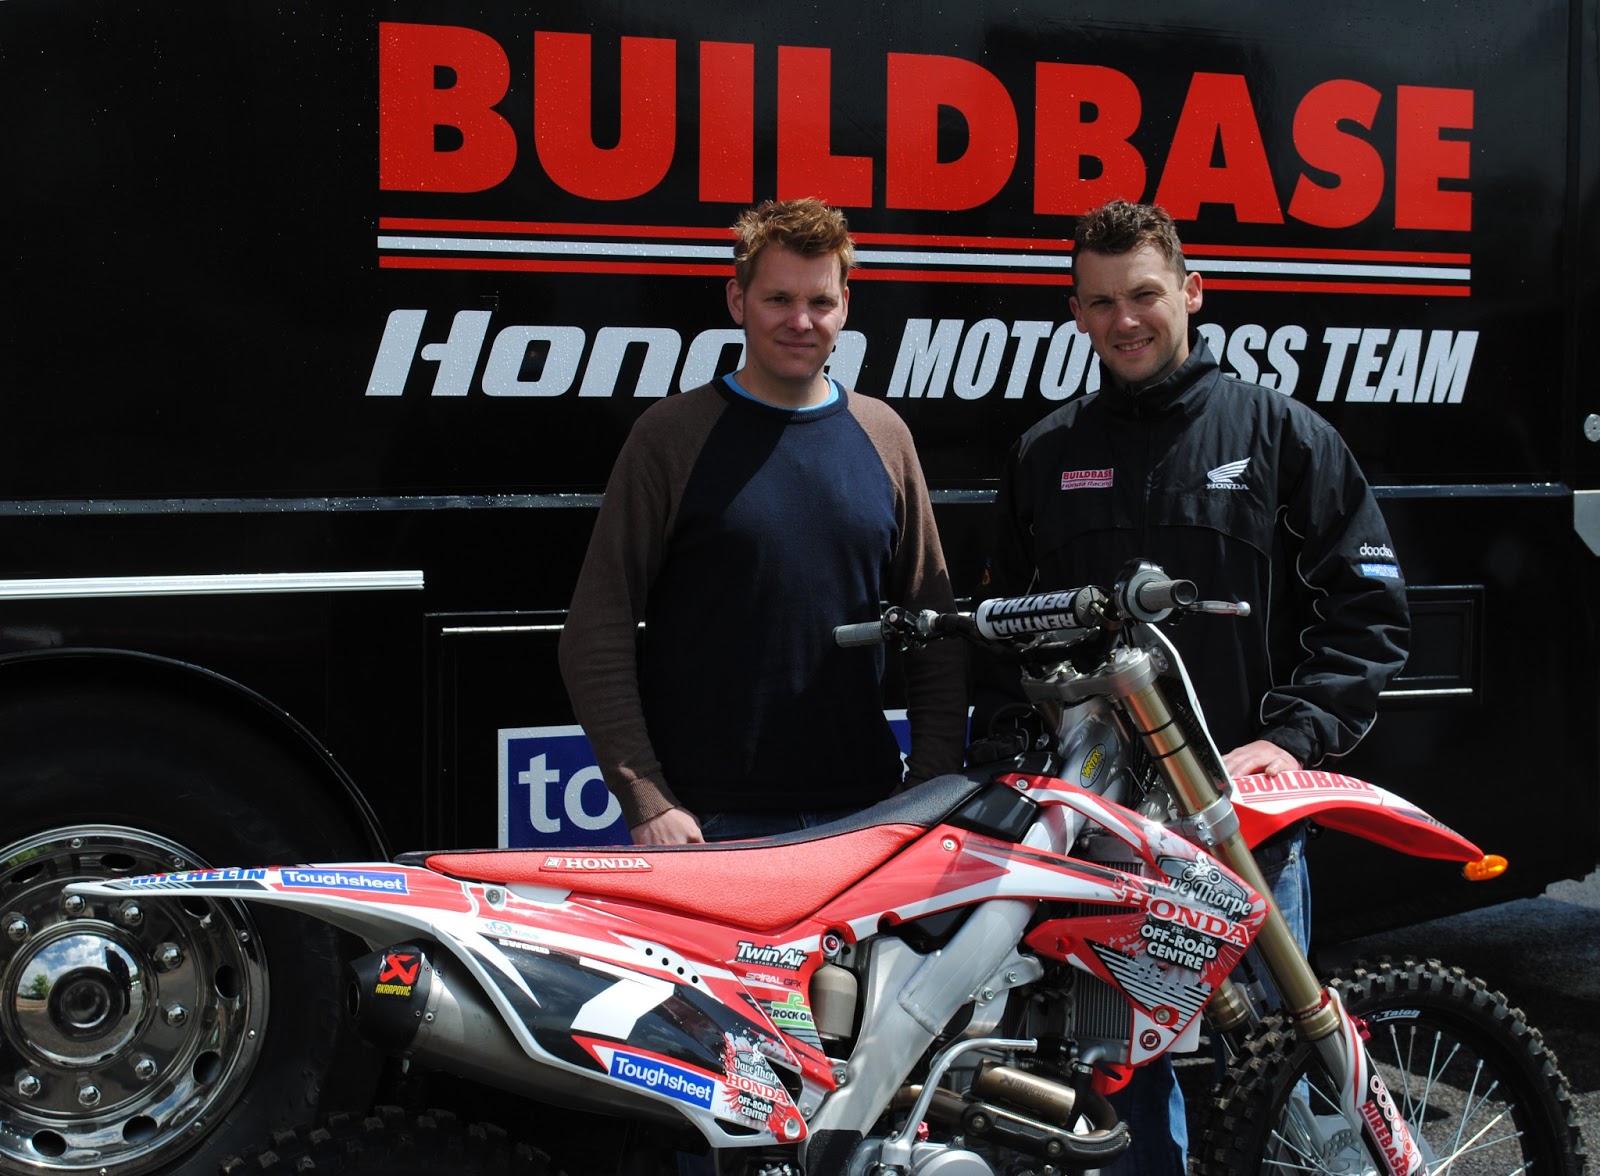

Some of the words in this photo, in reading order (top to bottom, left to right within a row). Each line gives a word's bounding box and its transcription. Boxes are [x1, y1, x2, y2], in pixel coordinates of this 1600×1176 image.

[379, 22, 1475, 231] BUILDBASE
[1317, 328, 1480, 404] TEAM
[1062, 469, 1113, 481] BUILDBASE
[564, 857, 651, 870] HONDA
[132, 869, 267, 885] MICHELIN
[284, 871, 403, 891] Toughsheet
[1193, 879, 1253, 917] Thorpe
[1122, 885, 1250, 948] HONDA
[737, 941, 781, 963] Twin
[781, 948, 808, 967] Air
[1140, 923, 1218, 960] OFF-ROAD
[1146, 941, 1205, 971] CENTRE
[745, 972, 784, 985] SPIRAL
[772, 1009, 798, 1020] ROCK
[615, 1057, 712, 1101] Toughsheet
[733, 1056, 754, 1076] Dave
[726, 1072, 789, 1104] HONDA
[738, 1094, 773, 1114] OFF-ROAD
[741, 1106, 768, 1122] CENTRE
[1361, 1099, 1408, 1176] HIREBASE
